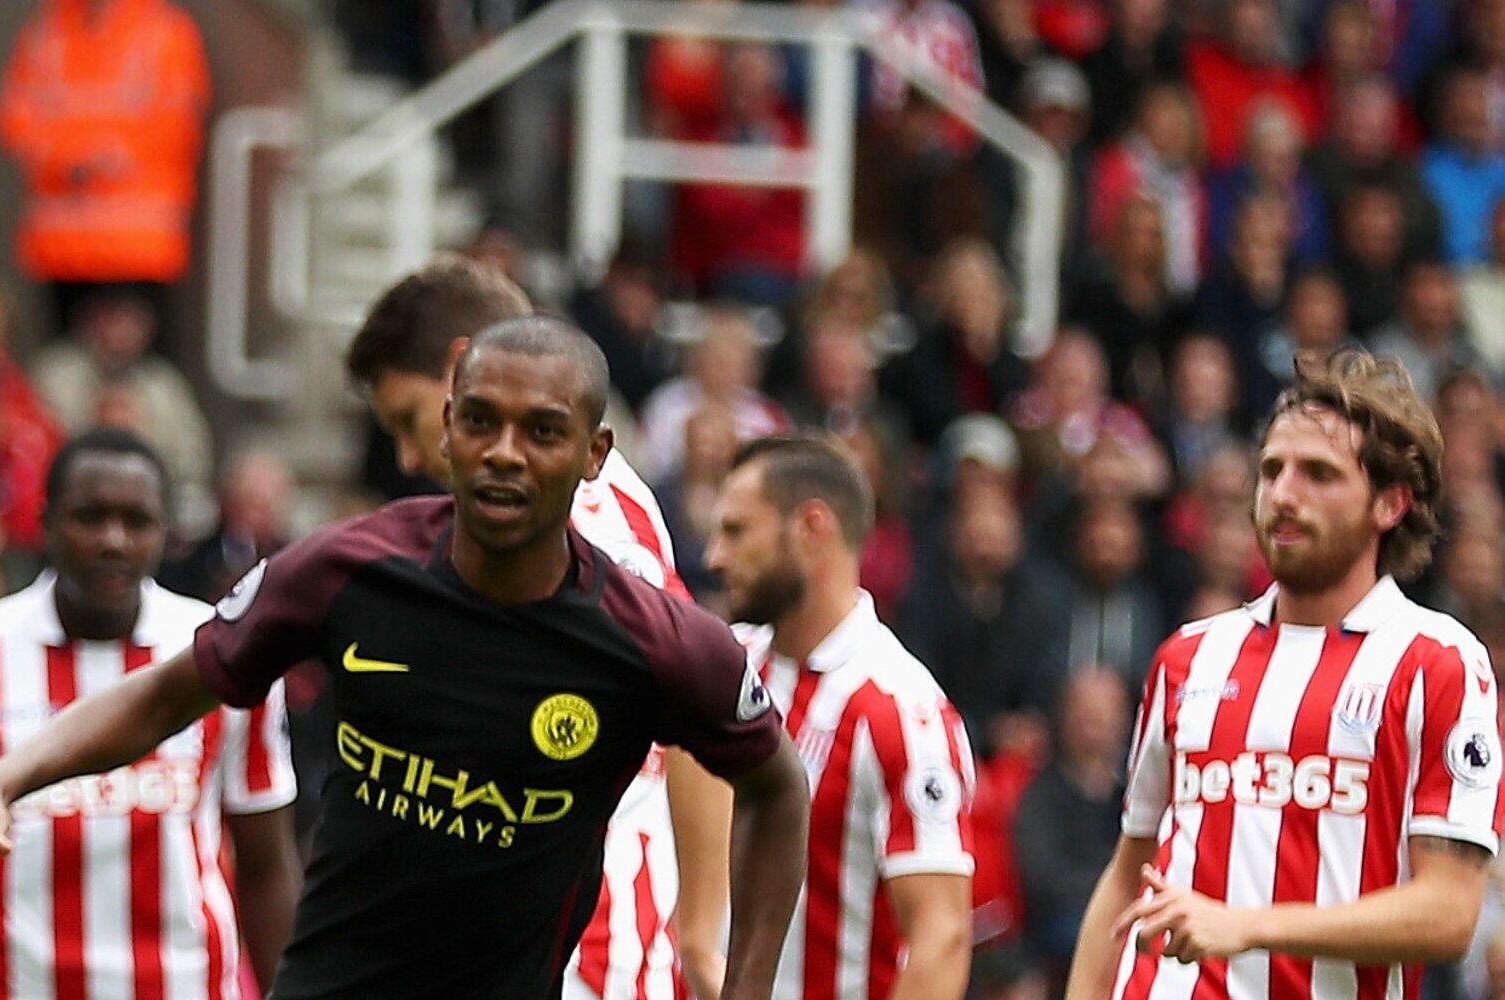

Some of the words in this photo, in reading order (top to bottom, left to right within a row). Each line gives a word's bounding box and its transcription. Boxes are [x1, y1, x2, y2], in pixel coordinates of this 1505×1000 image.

[337, 721, 574, 824] ETIHAD
[1174, 750, 1371, 815] bet365
[354, 780, 516, 848] AIRWAYS
